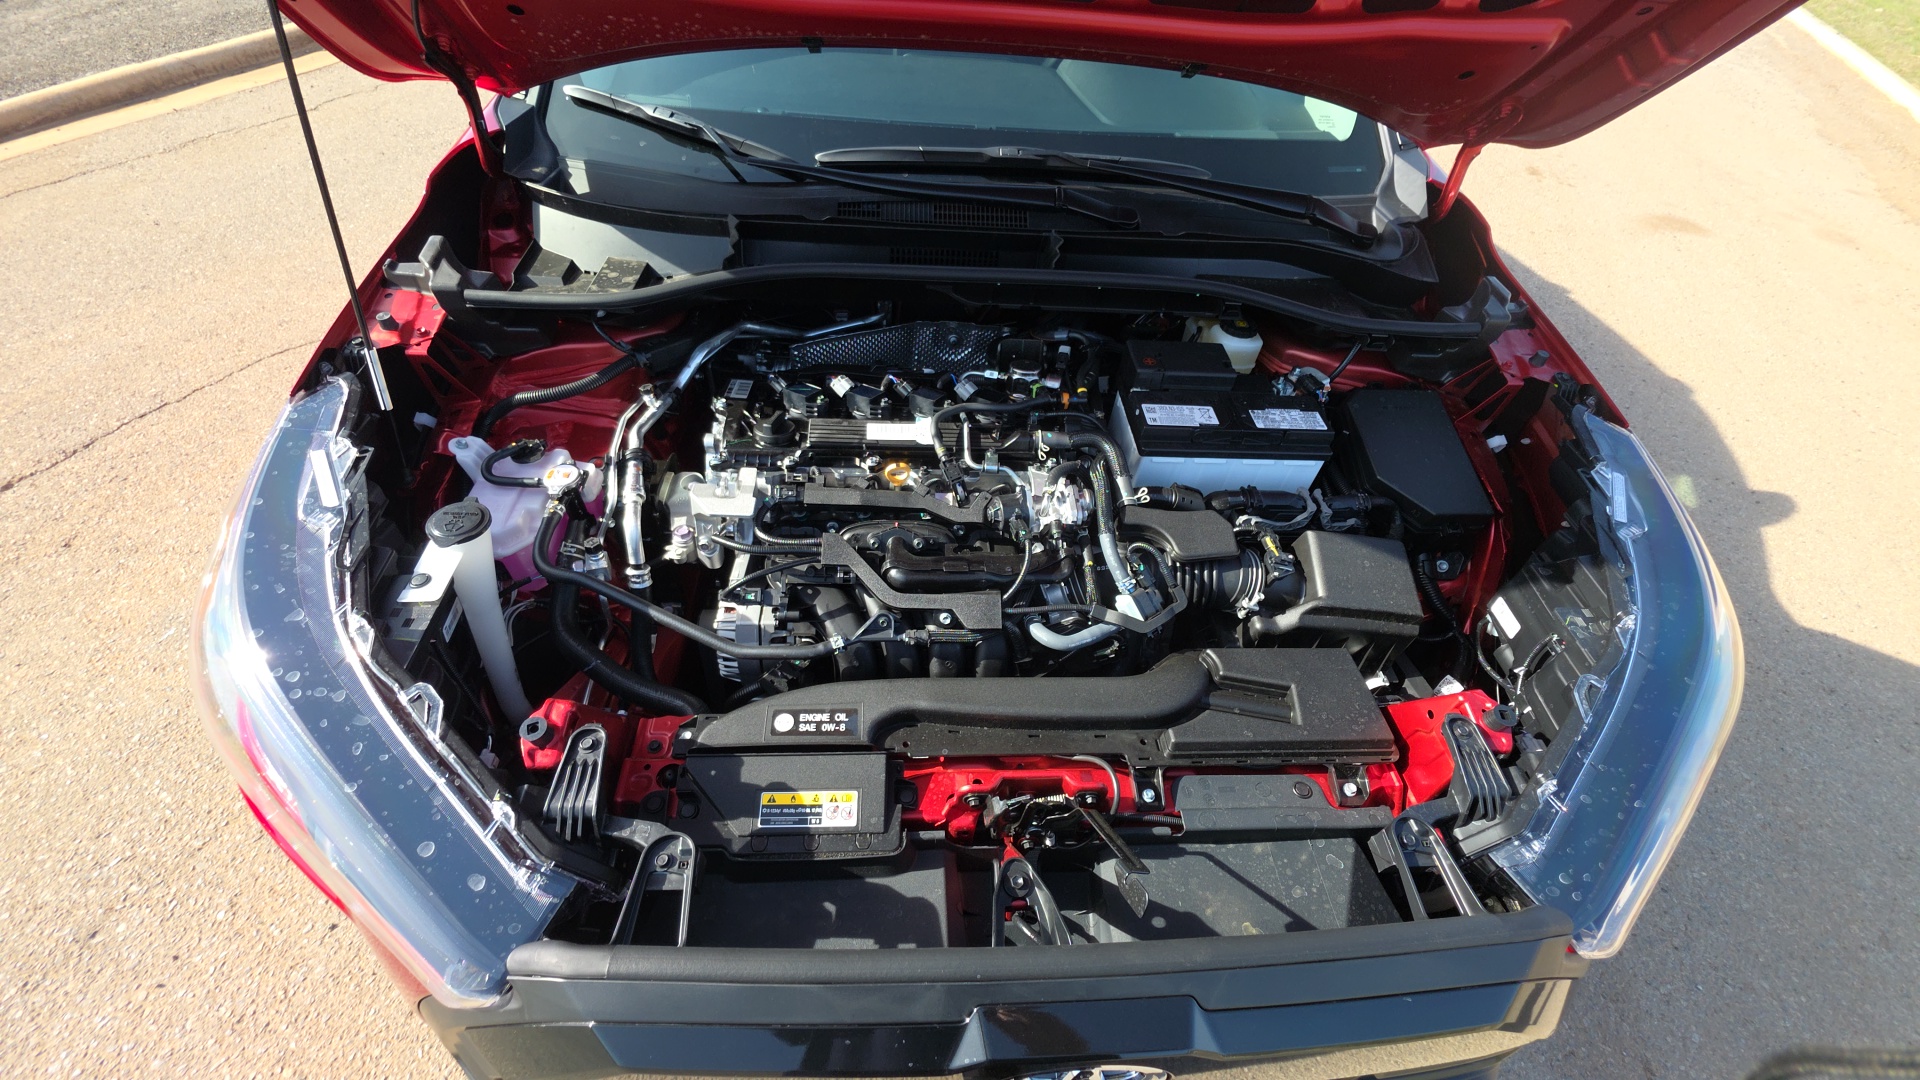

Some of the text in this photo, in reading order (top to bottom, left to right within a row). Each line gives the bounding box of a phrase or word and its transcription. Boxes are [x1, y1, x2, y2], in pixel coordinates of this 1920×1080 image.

[799, 713, 830, 722] ENGINE
[834, 713, 849, 722] OIL
[798, 724, 846, 732] SAE 0W-8
